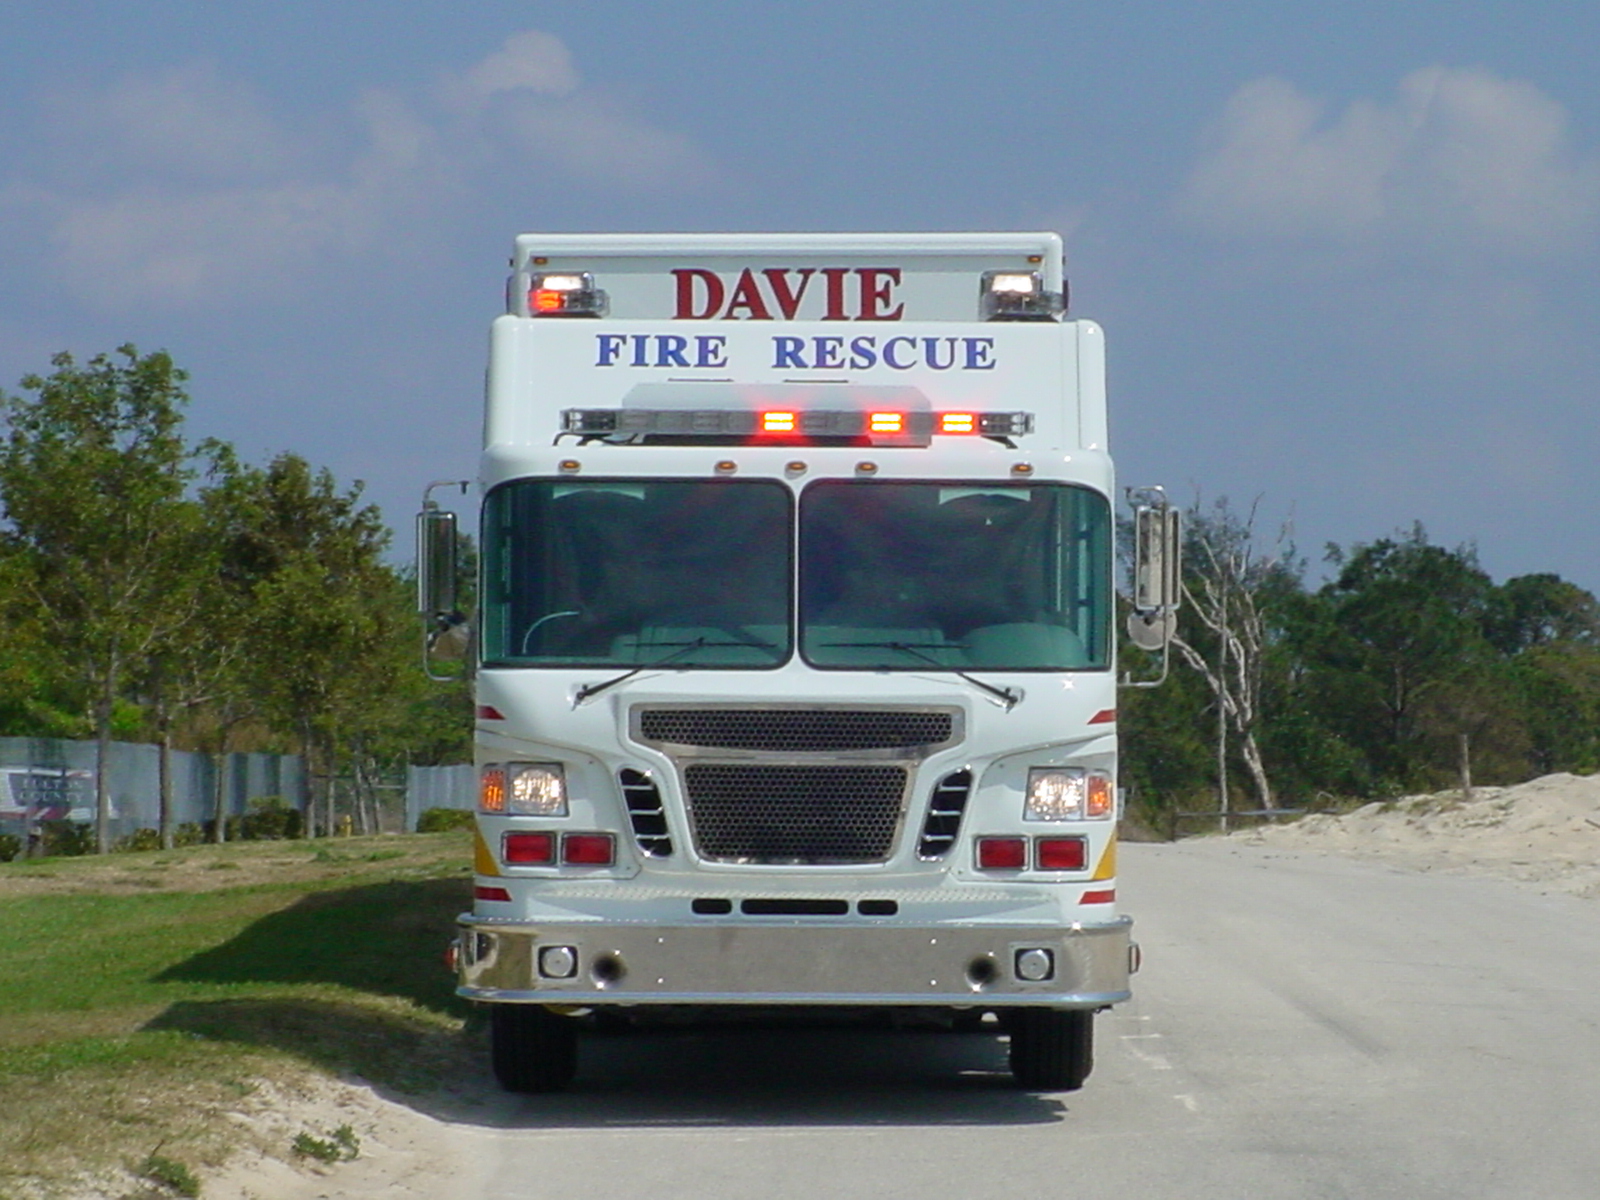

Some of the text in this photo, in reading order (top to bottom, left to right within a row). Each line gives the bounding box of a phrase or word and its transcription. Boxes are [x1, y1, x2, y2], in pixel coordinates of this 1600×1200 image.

[671, 268, 905, 321] DAVIE
[595, 334, 997, 370] FIRE RESCUE
